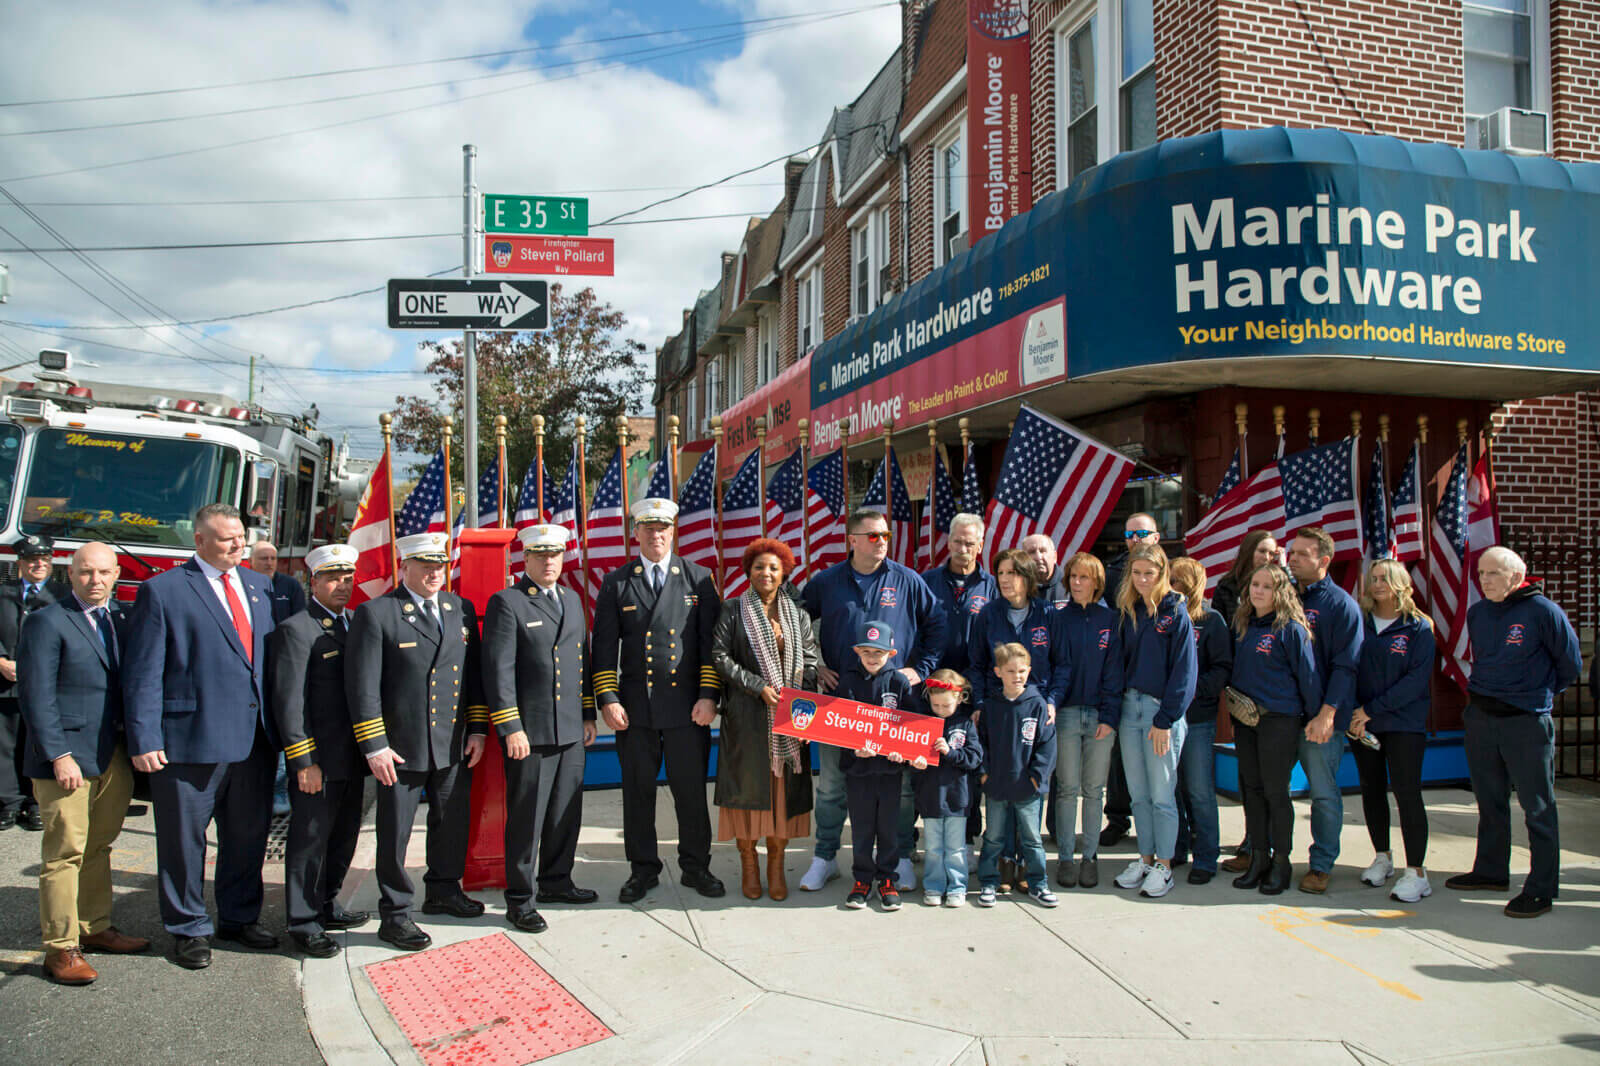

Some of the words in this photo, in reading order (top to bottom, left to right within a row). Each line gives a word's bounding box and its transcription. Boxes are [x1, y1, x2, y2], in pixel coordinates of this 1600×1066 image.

[984, 56, 1003, 125] Moore
[1008, 93, 1019, 153] Hardware
[983, 130, 1008, 230] Benjamin
[1008, 155, 1019, 182] Park
[494, 199, 506, 227] E
[519, 200, 547, 228] 35
[560, 202, 576, 220] St
[1008, 185, 1019, 217] arine
[1171, 193, 1406, 255] Marine
[1424, 204, 1538, 263] Park
[520, 247, 559, 261] Steven
[564, 249, 605, 262] Pollard
[543, 239, 580, 248] Firefighter
[555, 264, 569, 274] Way
[1174, 250, 1483, 315] Hardware
[405, 294, 448, 314] ONE
[478, 295, 522, 314] WAY
[832, 352, 870, 391] Marine
[873, 328, 902, 370] Park
[906, 286, 993, 353] Hardware
[998, 263, 1050, 300] 718-375-1821
[1178, 323, 1240, 345] Your
[1245, 318, 1416, 345] Neighborhood
[1420, 325, 1513, 351] Hardware
[1517, 331, 1567, 355] Store
[1028, 339, 1059, 356] Benjamin
[1033, 353, 1054, 366] Moore
[814, 407, 859, 448] Benjain
[861, 395, 902, 430] Moore
[908, 400, 921, 416] The
[920, 391, 945, 411] Leader
[945, 388, 953, 402] In
[953, 379, 975, 399] Paint
[975, 376, 983, 392] &
[983, 367, 1009, 389] Color
[65, 433, 126, 451] Memory
[129, 439, 147, 453] of
[727, 420, 745, 451] First
[37, 505, 94, 523] Timothy
[119, 511, 159, 527] Klein
[824, 710, 874, 735] Steven
[879, 721, 931, 746] Pollard
[856, 705, 902, 722] Firefighter
[865, 738, 883, 752] Way
